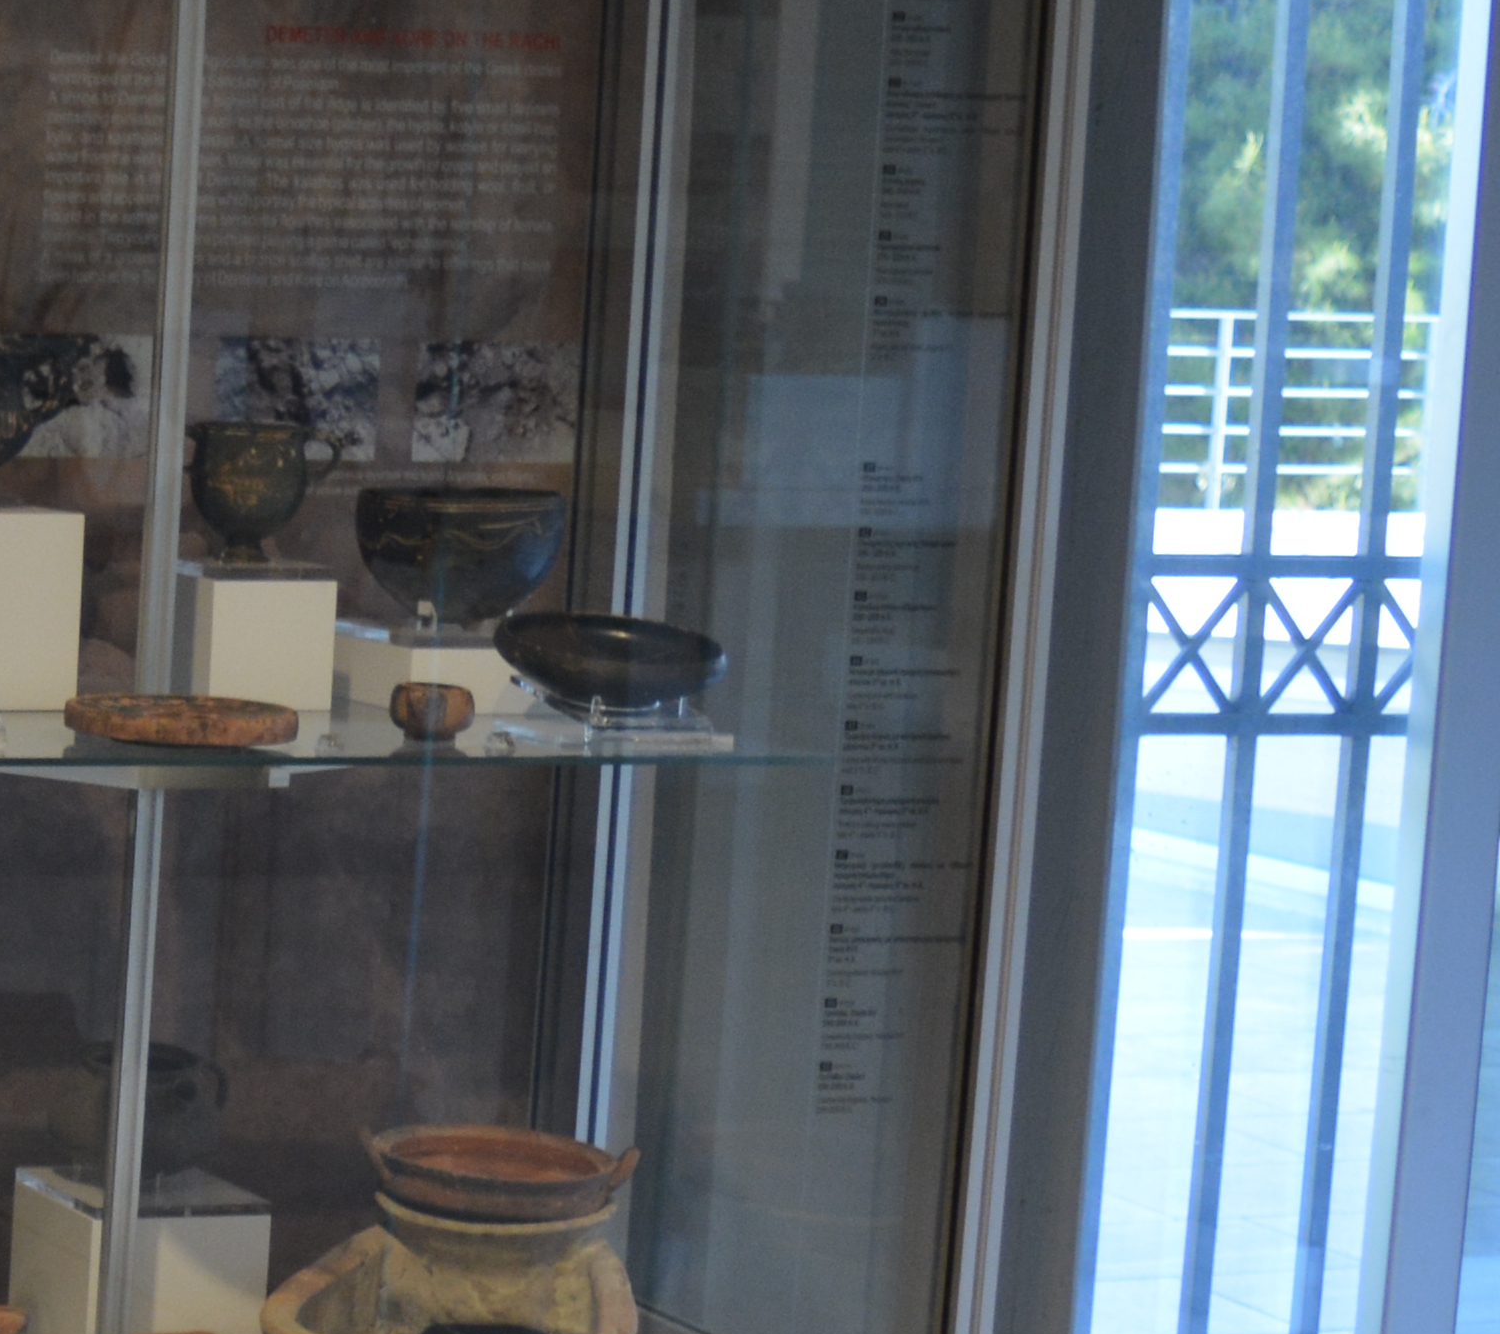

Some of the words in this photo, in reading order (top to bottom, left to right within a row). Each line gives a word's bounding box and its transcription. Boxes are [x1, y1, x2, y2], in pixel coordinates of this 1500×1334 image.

[265, 24, 347, 45] DEMETER
[443, 28, 468, 48] ON
[509, 31, 562, 51] RACHI
